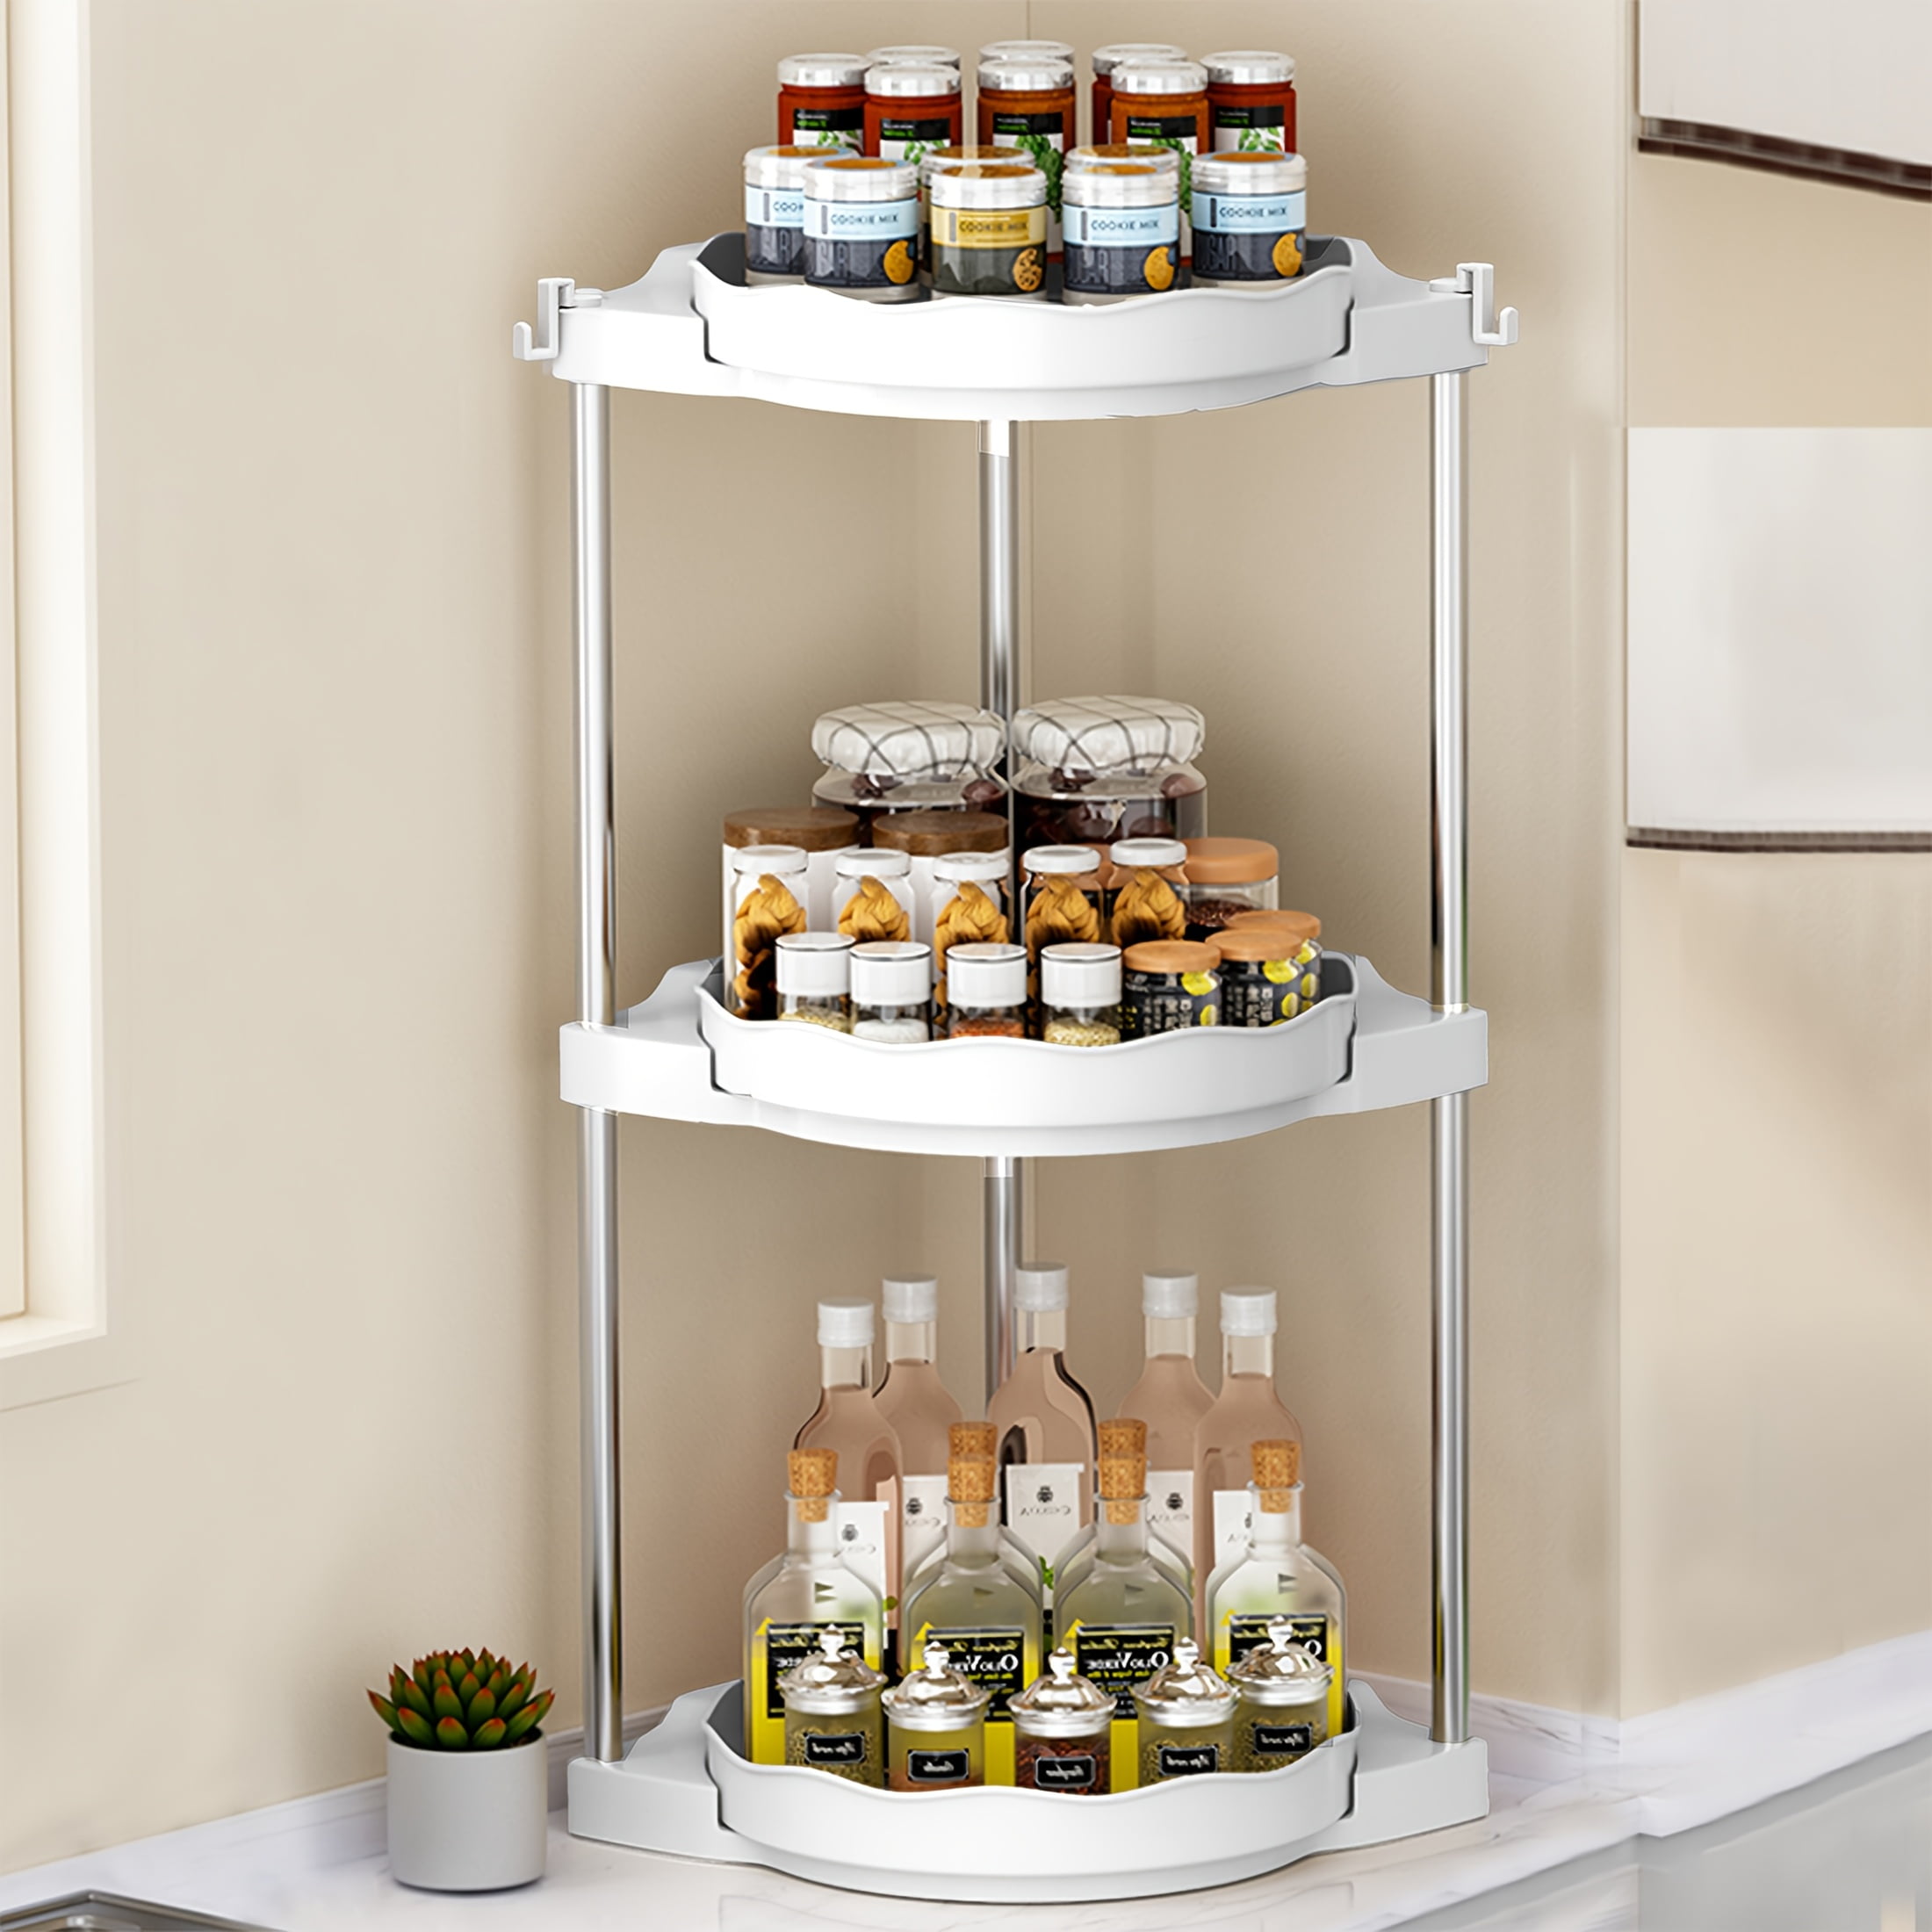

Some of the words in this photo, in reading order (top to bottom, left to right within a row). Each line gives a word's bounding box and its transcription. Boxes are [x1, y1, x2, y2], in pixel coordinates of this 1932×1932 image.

[1219, 206, 1265, 219] COOKIE
[1267, 206, 1287, 216] MIX
[831, 214, 876, 226] COOKIE
[879, 213, 899, 224] MIX
[1091, 220, 1135, 231] COOKIE
[1139, 220, 1159, 228] MIX
[959, 220, 1004, 233] COOKIE
[1007, 220, 1027, 232] MIX
